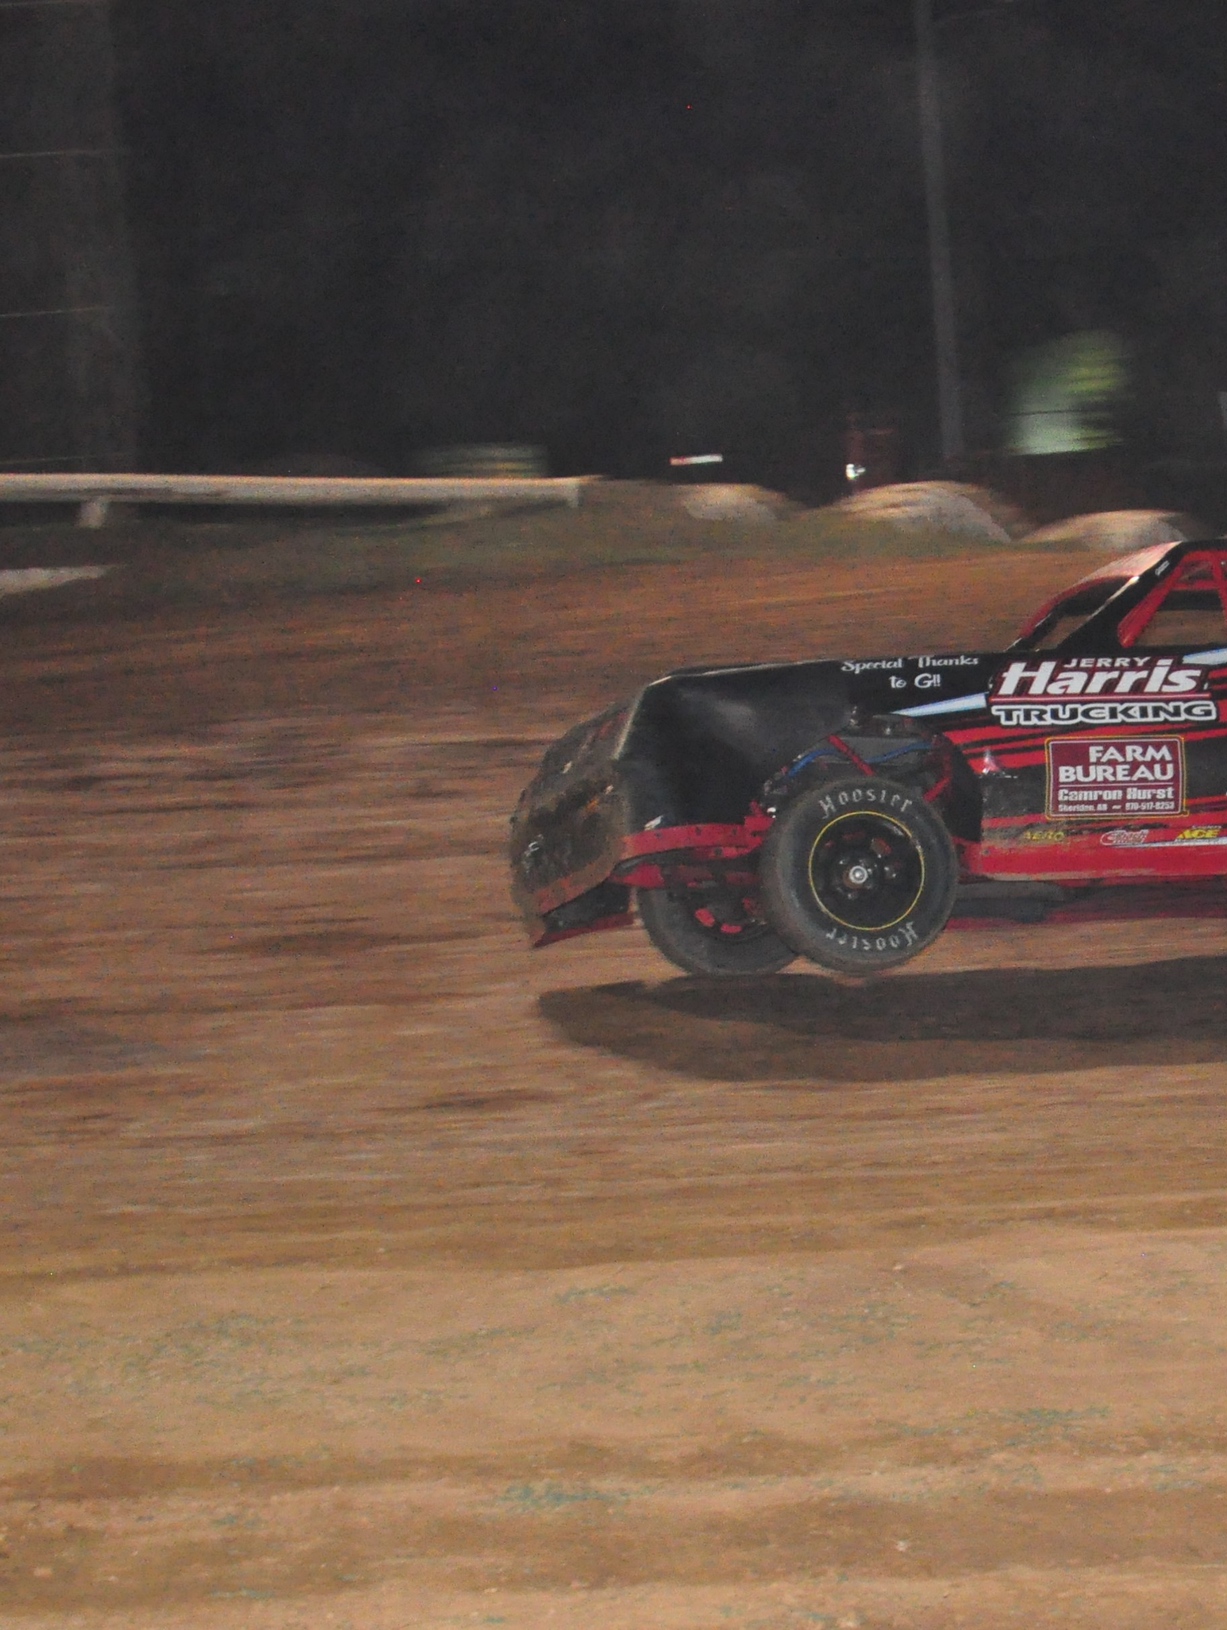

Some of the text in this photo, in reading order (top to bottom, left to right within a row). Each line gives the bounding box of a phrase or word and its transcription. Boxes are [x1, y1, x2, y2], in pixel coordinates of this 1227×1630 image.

[841, 655, 979, 674] Special Thanks
[1064, 657, 1150, 667] JERRY
[889, 675, 907, 688] to
[998, 659, 1201, 694] Harris
[991, 700, 1216, 725] TRUCKING
[1089, 745, 1172, 762] FARM
[1059, 764, 1174, 782] BUREAU
[1058, 787, 1174, 801] Camron Hurst
